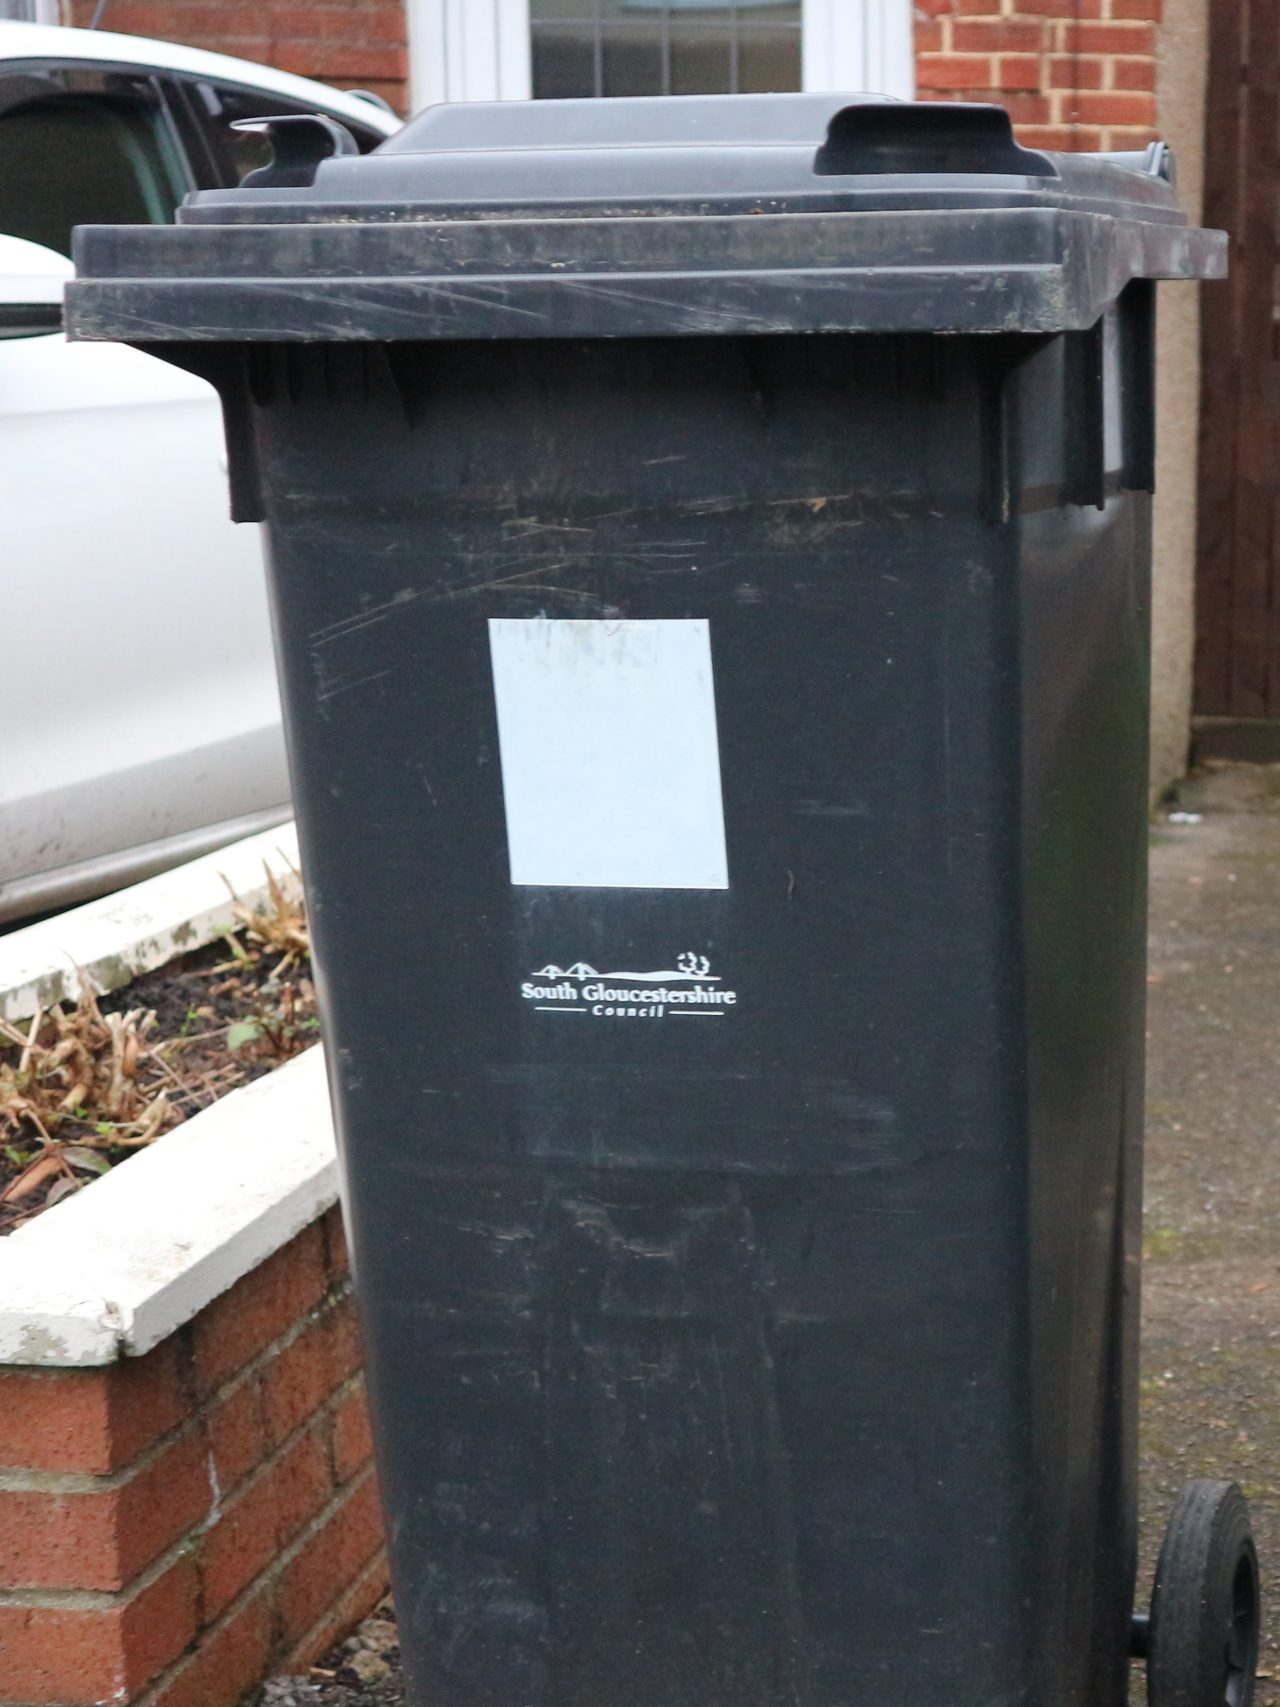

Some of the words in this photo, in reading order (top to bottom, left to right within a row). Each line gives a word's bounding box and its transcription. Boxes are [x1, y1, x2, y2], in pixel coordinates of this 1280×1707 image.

[521, 982, 577, 1000] South
[581, 983, 737, 1004] Gloucestershire
[592, 1004, 664, 1017] Council
